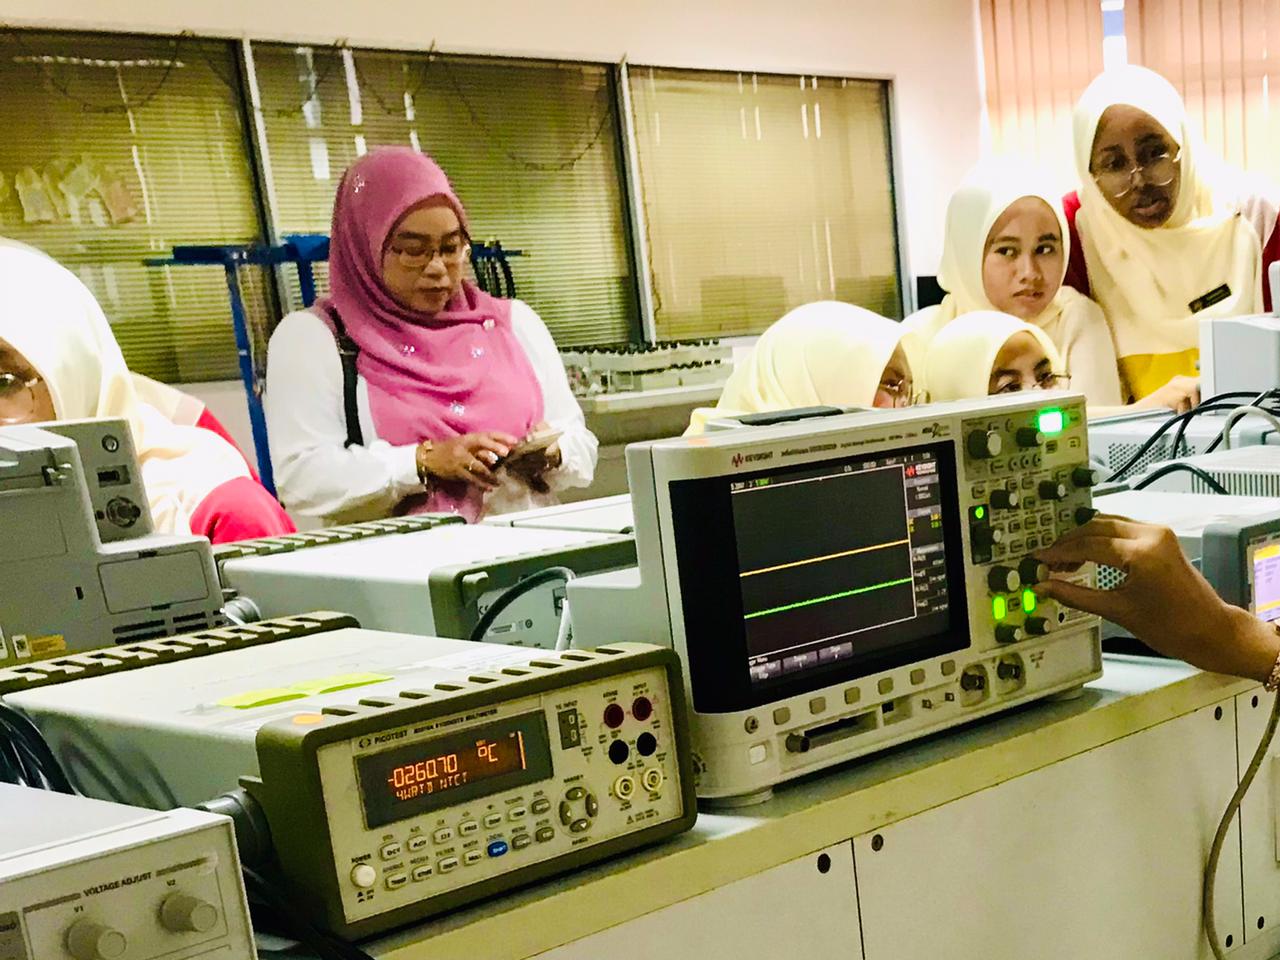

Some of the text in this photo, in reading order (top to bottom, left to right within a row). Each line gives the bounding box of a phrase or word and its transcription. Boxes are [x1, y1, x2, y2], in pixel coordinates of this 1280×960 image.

[745, 452, 774, 463] KEYSIGHT
[374, 730, 407, 744] PICOTEST
[83, 872, 152, 897] VOLTAGE ADJUST
[166, 879, 176, 887] V2
[74, 905, 84, 913] V1
